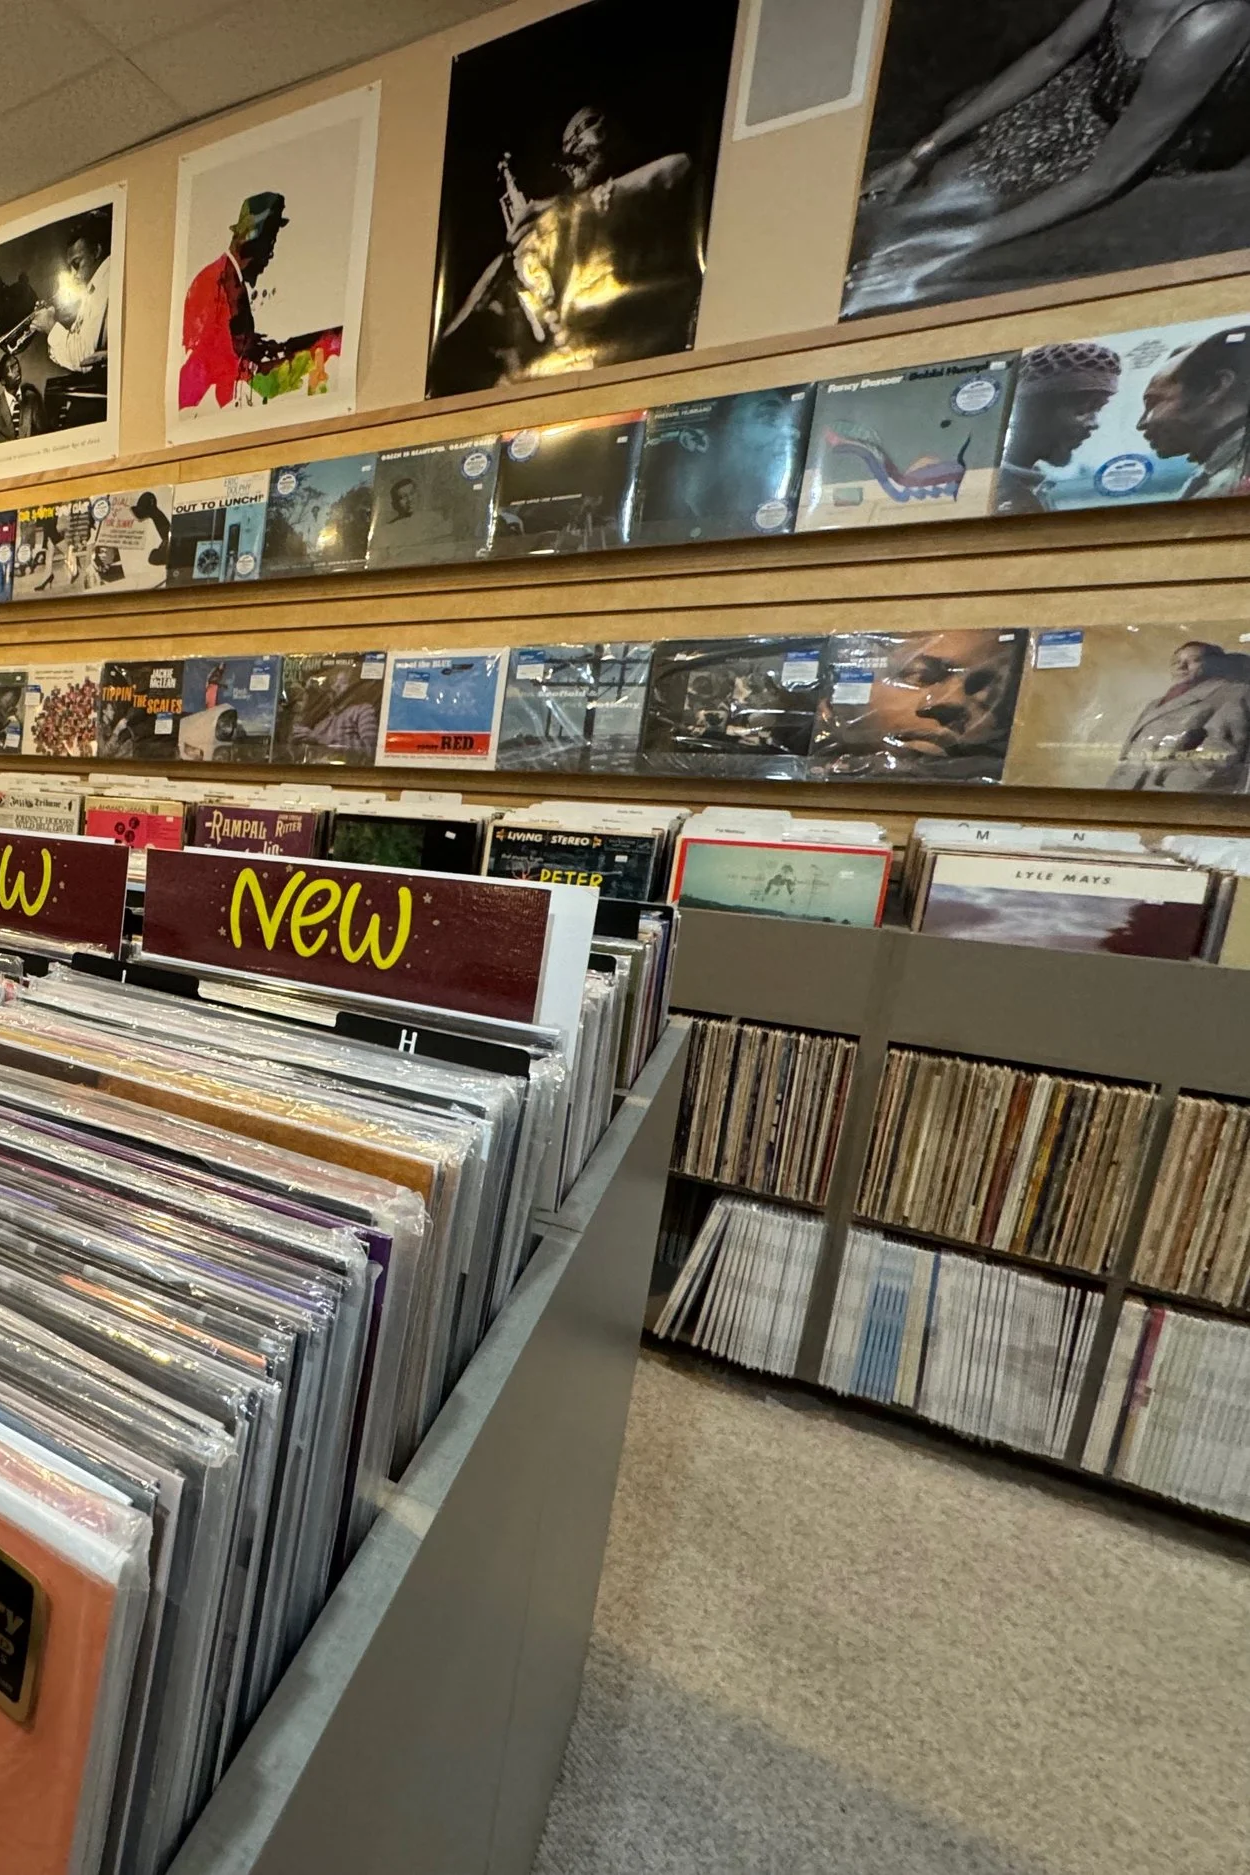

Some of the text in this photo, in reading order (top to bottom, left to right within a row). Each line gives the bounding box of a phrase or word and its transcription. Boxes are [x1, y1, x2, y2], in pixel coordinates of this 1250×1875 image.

[827, 382, 859, 394] Fancy
[861, 376, 904, 389] Dancer
[411, 445, 446, 457] BEAUTIFUL
[201, 501, 216, 511] TO
[152, 668, 174, 678] JACKIE
[102, 684, 183, 715] TIPPIN' THE SCALES
[441, 735, 475, 751] RED
[34, 798, 62, 808] Tribune
[14, 814, 75, 825] JOHNNY HODGES
[15, 822, 34, 830] WILD
[507, 831, 591, 847] LIVING STEREO
[976, 830, 990, 840] M
[1073, 832, 1086, 842] N
[540, 868, 604, 887] PETER
[1015, 870, 1112, 885] LYLE MAYS
[230, 866, 412, 970] New
[398, 1029, 419, 1055] H
